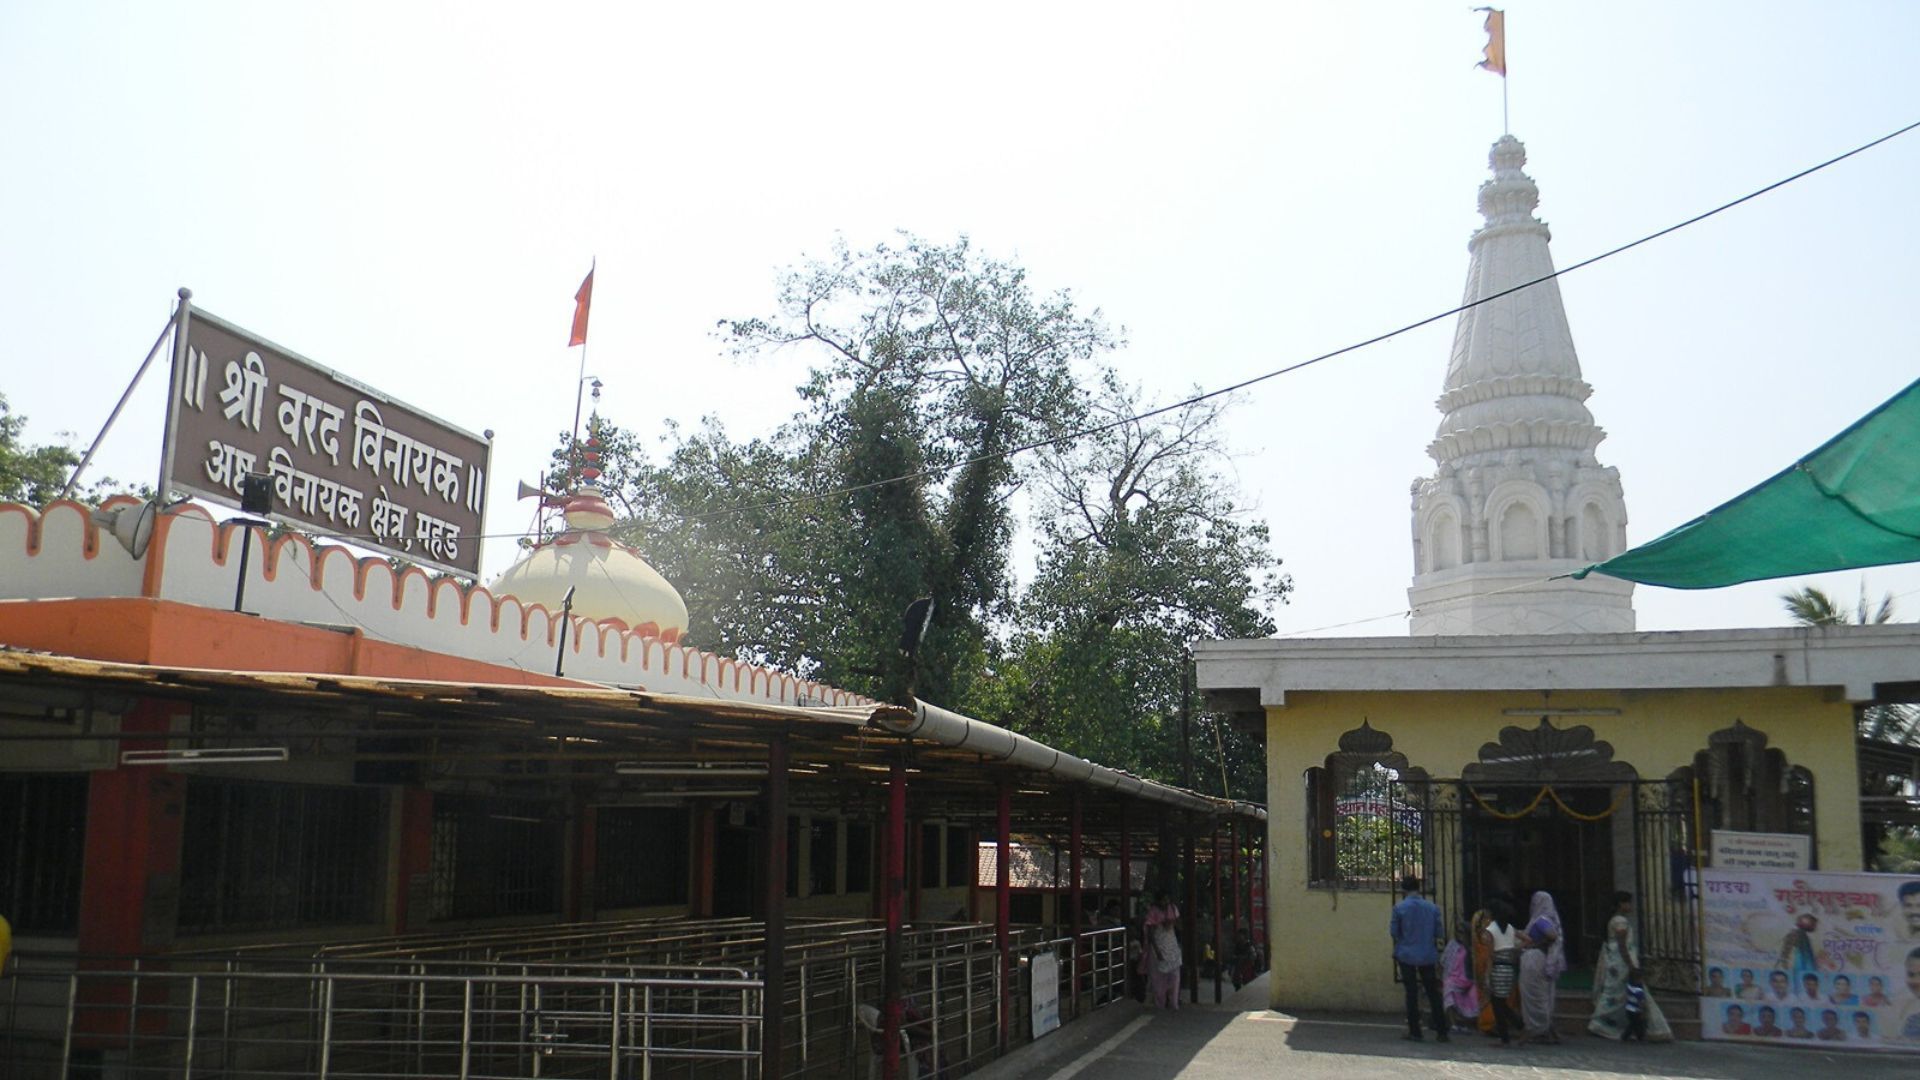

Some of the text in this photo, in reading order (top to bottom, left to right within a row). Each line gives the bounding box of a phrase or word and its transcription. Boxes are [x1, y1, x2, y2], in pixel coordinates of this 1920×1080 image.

[218, 351, 268, 433] श्री
[278, 384, 345, 467] वरद
[352, 400, 463, 504] विनायक
[268, 446, 363, 530] विनायक
[415, 512, 461, 560] महड
